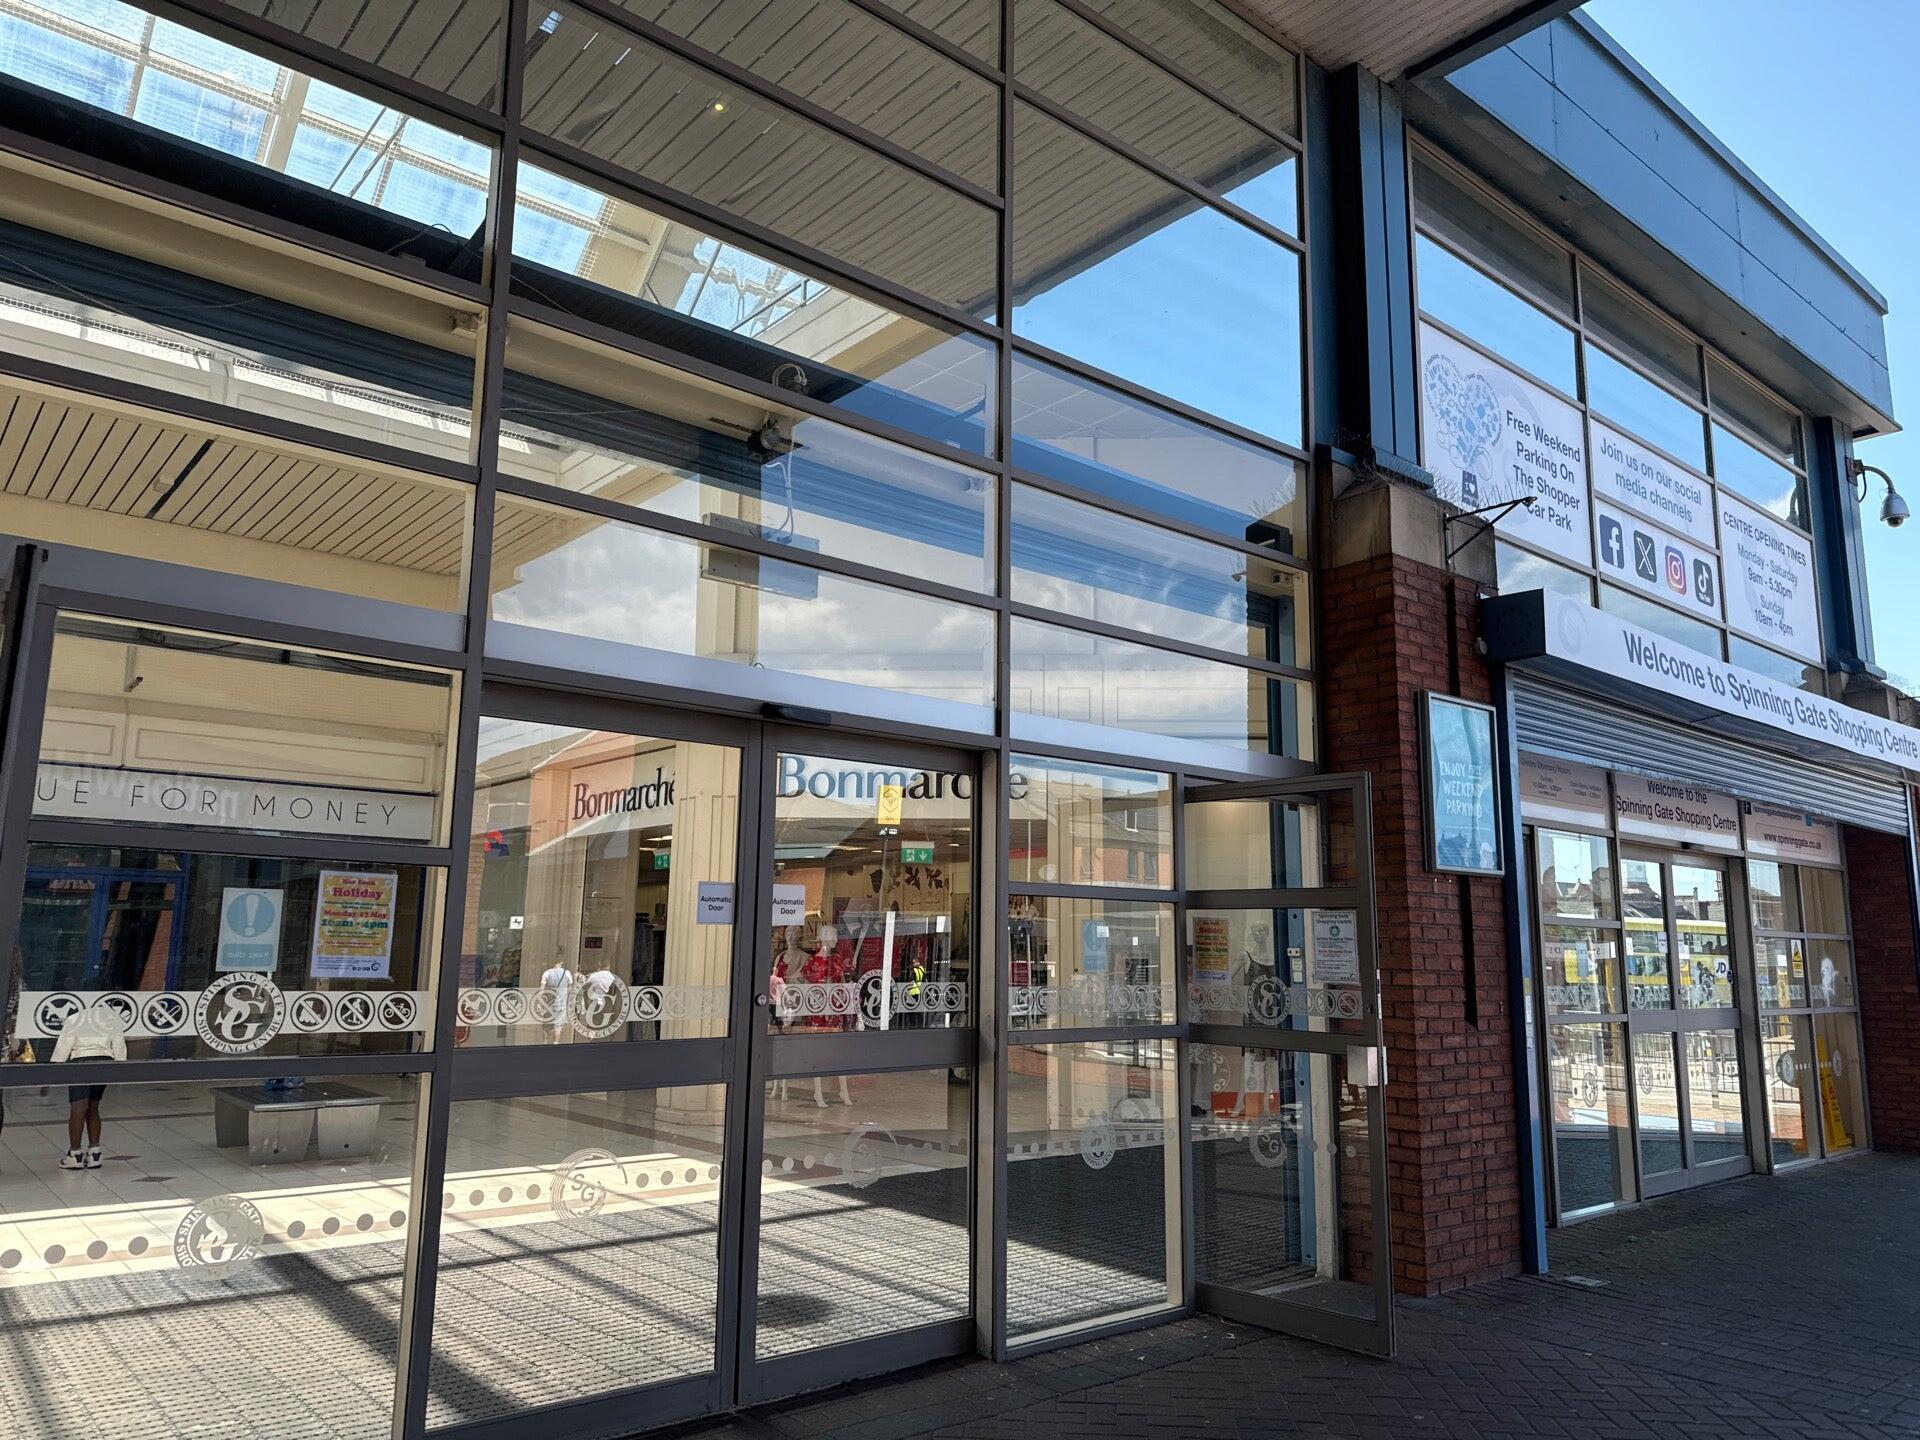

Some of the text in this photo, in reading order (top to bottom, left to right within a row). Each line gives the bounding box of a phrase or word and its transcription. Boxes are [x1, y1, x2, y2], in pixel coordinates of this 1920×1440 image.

[1506, 410, 1531, 437] Free
[1533, 423, 1581, 463] Weekend
[1516, 440, 1575, 484] Parking On
[1600, 437, 1702, 505] Join us on our social
[1513, 465, 1580, 511] The Shopper
[1615, 472, 1693, 524] media channels
[1527, 502, 1573, 532] Car Park
[1723, 512, 1807, 567] CENTRE OPENING TIMES
[1737, 542, 1765, 569] Monday
[1770, 560, 1798, 587] Saturday
[1748, 567, 1764, 586] 9am
[1769, 578, 1793, 600] 5.30pm
[1754, 609, 1773, 628] 10am
[1779, 620, 1794, 637] 4pm
[1760, 594, 1785, 619] Sunday
[1622, 630, 1919, 760] Welcome to Spinning Gate Shopping Centre
[1440, 760, 1466, 778] ENJOY
[37, 778, 397, 825] UE FOR MONEY
[1443, 779, 1483, 798] WEEKEND
[1647, 780, 1708, 804] Welcome to the
[1446, 799, 1483, 818] PARKING
[1616, 795, 1653, 820] Spinning
[1654, 803, 1674, 820] Gate
[1675, 806, 1712, 831] Shopping
[1713, 813, 1737, 832] Centre
[332, 887, 384, 900] Holiday
[772, 898, 805, 906] Automatic
[324, 909, 357, 918] Monday
[370, 910, 387, 919] May
[362, 920, 388, 930] 4pm
[199, 973, 258, 1010] SPINNING
[198, 1019, 281, 1054] SHOPPING CENTRE
